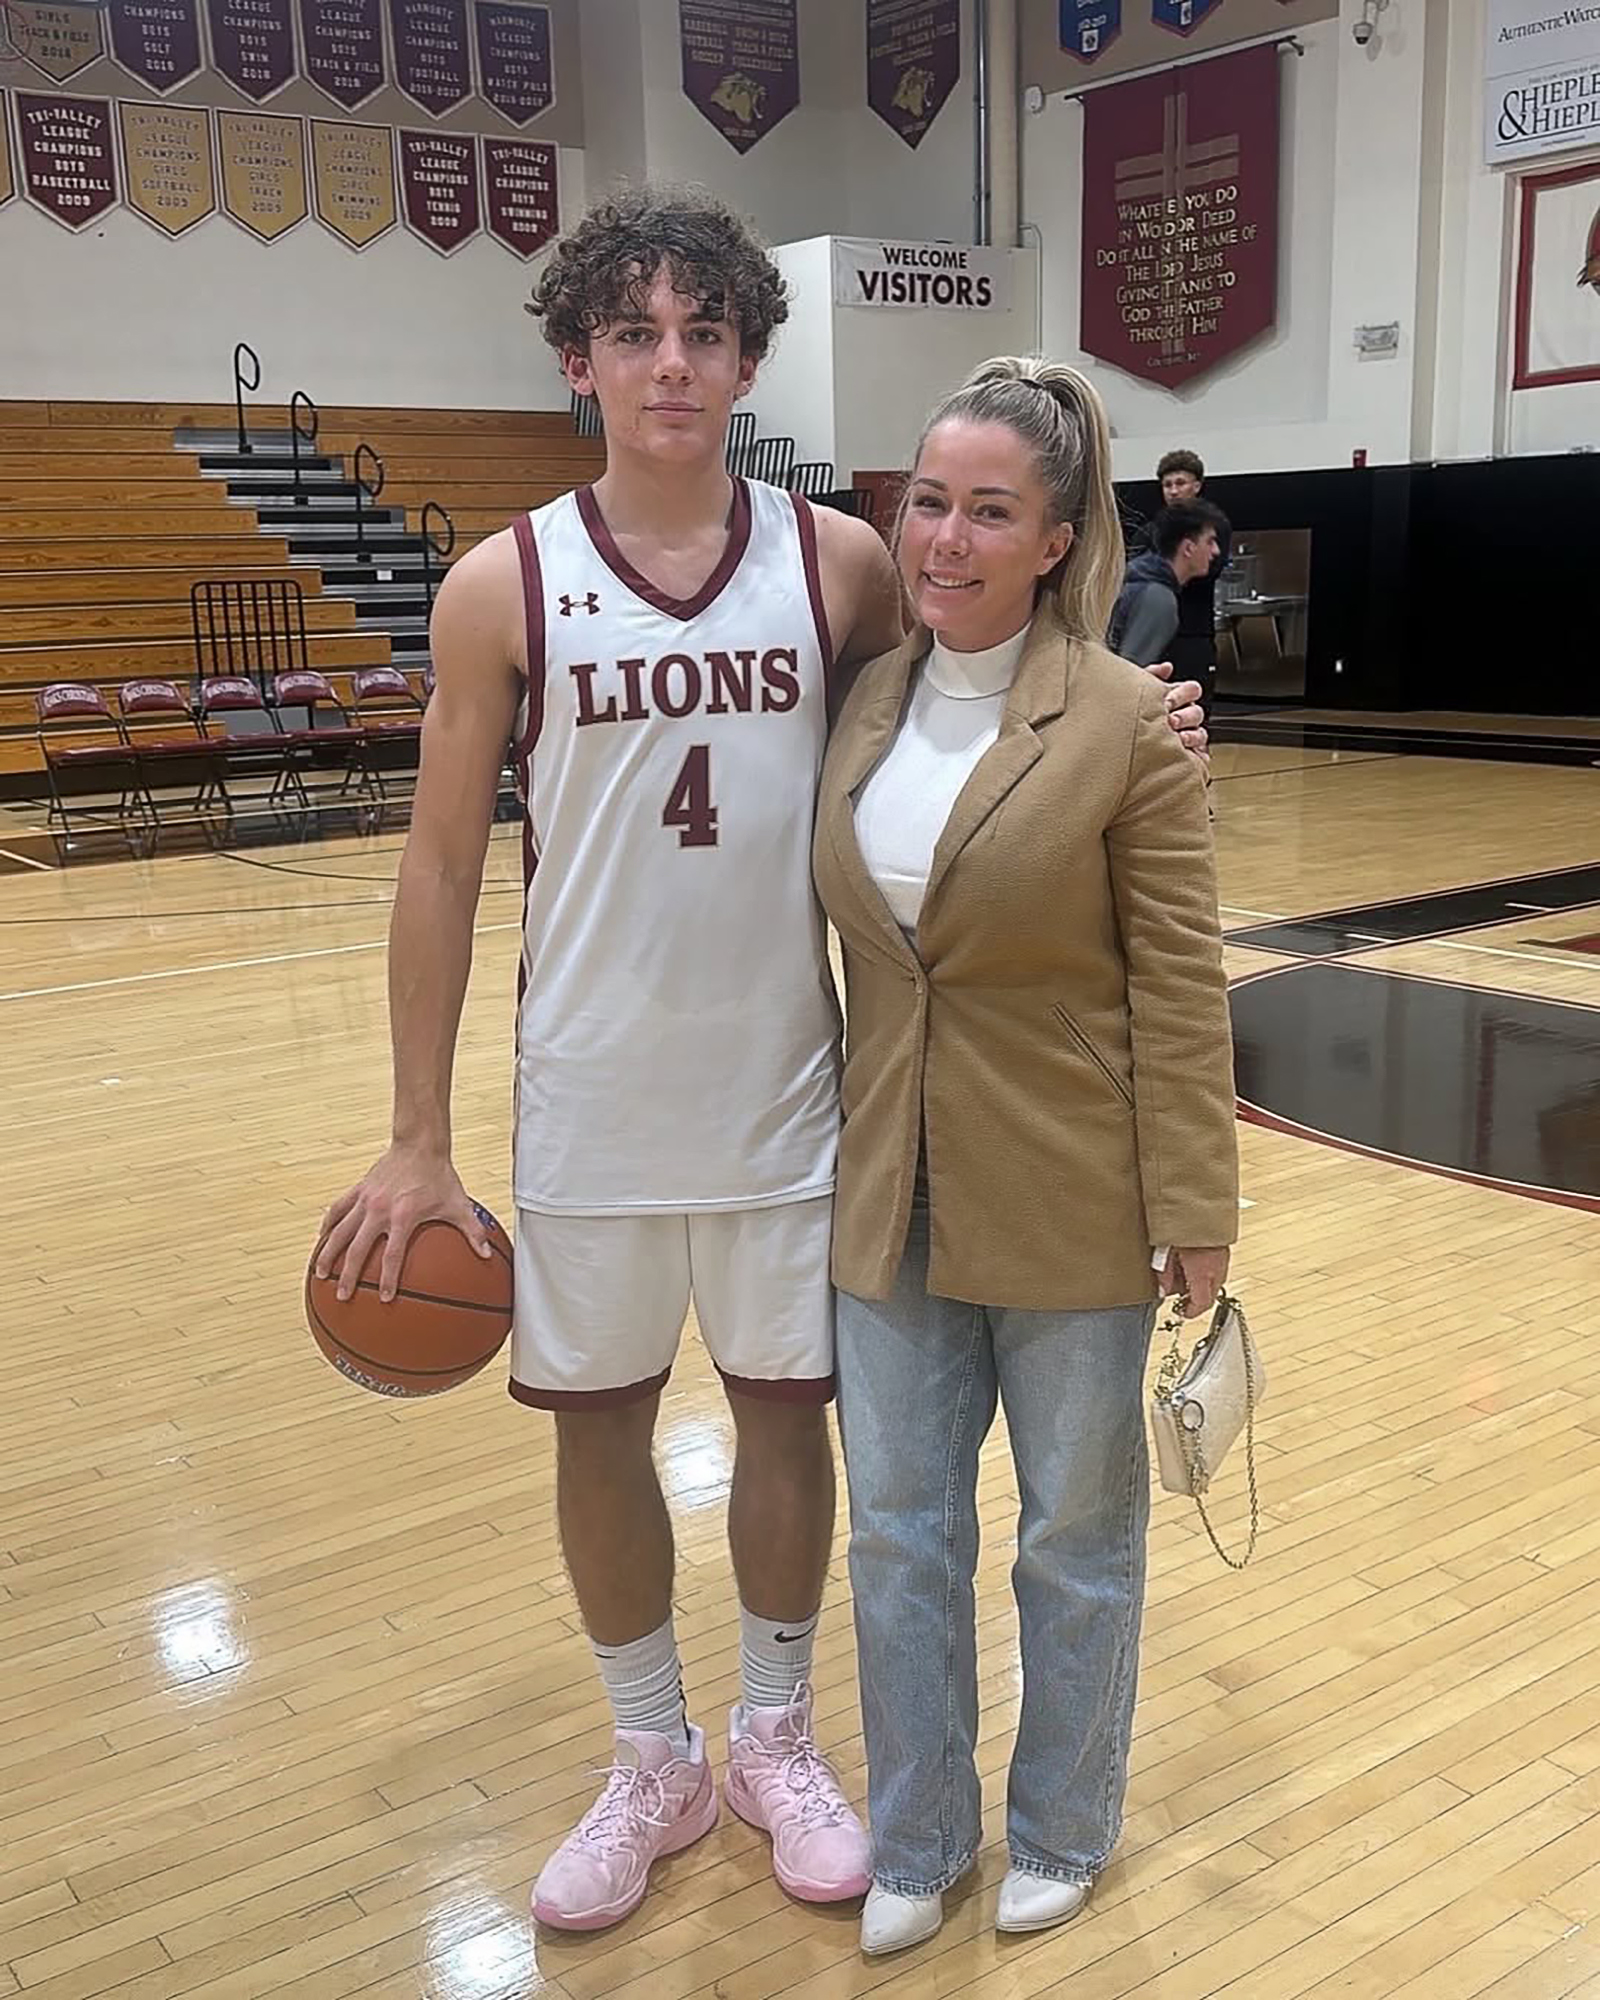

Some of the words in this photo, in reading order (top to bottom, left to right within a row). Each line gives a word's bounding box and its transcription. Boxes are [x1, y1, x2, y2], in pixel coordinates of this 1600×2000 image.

[123, 5, 187, 21] CHAMPIONS
[320, 9, 362, 23] LEAGUE
[141, 24, 171, 37] BOYS
[222, 16, 283, 31] CHAMPIONS
[314, 25, 372, 41] CHAMPIONS
[239, 34, 268, 47] BOYS
[404, 35, 459, 51] CHAMPIONS
[143, 41, 172, 55] GOLF
[331, 43, 358, 56] BOYS
[240, 51, 270, 63] SWIM
[309, 57, 340, 71] TRACK
[408, 67, 460, 82] FOOTBALL
[27, 108, 101, 128] TRI-VALLEY
[130, 116, 199, 131] TRI-VALLEY
[41, 125, 90, 139] LEAGUE
[145, 133, 189, 146] LEAGUE
[34, 141, 102, 157] CHAMPIONS
[239, 141, 284, 153] LEAGUE
[409, 141, 469, 159] TRI-VALLEY
[136, 149, 201, 163] CHAMPIONS
[232, 155, 294, 169] CHAMPIONS
[420, 156, 460, 170] LEAGUE
[491, 147, 548, 165] TRI-VALLEY
[55, 160, 86, 172] BOYS
[153, 165, 188, 177] GIRLS
[324, 163, 383, 177] CHAMPIONS
[502, 164, 541, 177] LEAGUE
[32, 174, 111, 190] BASKETBALL
[249, 171, 281, 183] GIRLS
[413, 171, 469, 185] CHAMPIONS
[496, 177, 550, 191] CHAMPIONS
[141, 179, 200, 194] SOFTBALL
[249, 186, 283, 198] TRACK
[429, 187, 455, 199] BOYS
[57, 194, 91, 206] 2009
[511, 192, 535, 205] BOYS
[1215, 185, 1237, 204] DO
[426, 200, 461, 213] TENNIS
[501, 206, 548, 220] SWIMMING
[1202, 209, 1236, 229] DEED
[1097, 250, 1117, 267] DO
[1132, 245, 1155, 261] ALL
[1202, 229, 1239, 249] NAME
[882, 247, 968, 269] WELCOME
[1125, 265, 1151, 283] THE
[1190, 252, 1224, 272] JESUS
[857, 270, 992, 307] VISITORS
[1116, 285, 1160, 304] GIVING
[1217, 272, 1236, 289] TO
[1122, 305, 1151, 324] GOD
[1178, 296, 1224, 316] FATHER
[1192, 317, 1218, 335] HIM
[569, 647, 802, 728] LIONS
[659, 741, 721, 850] 4
